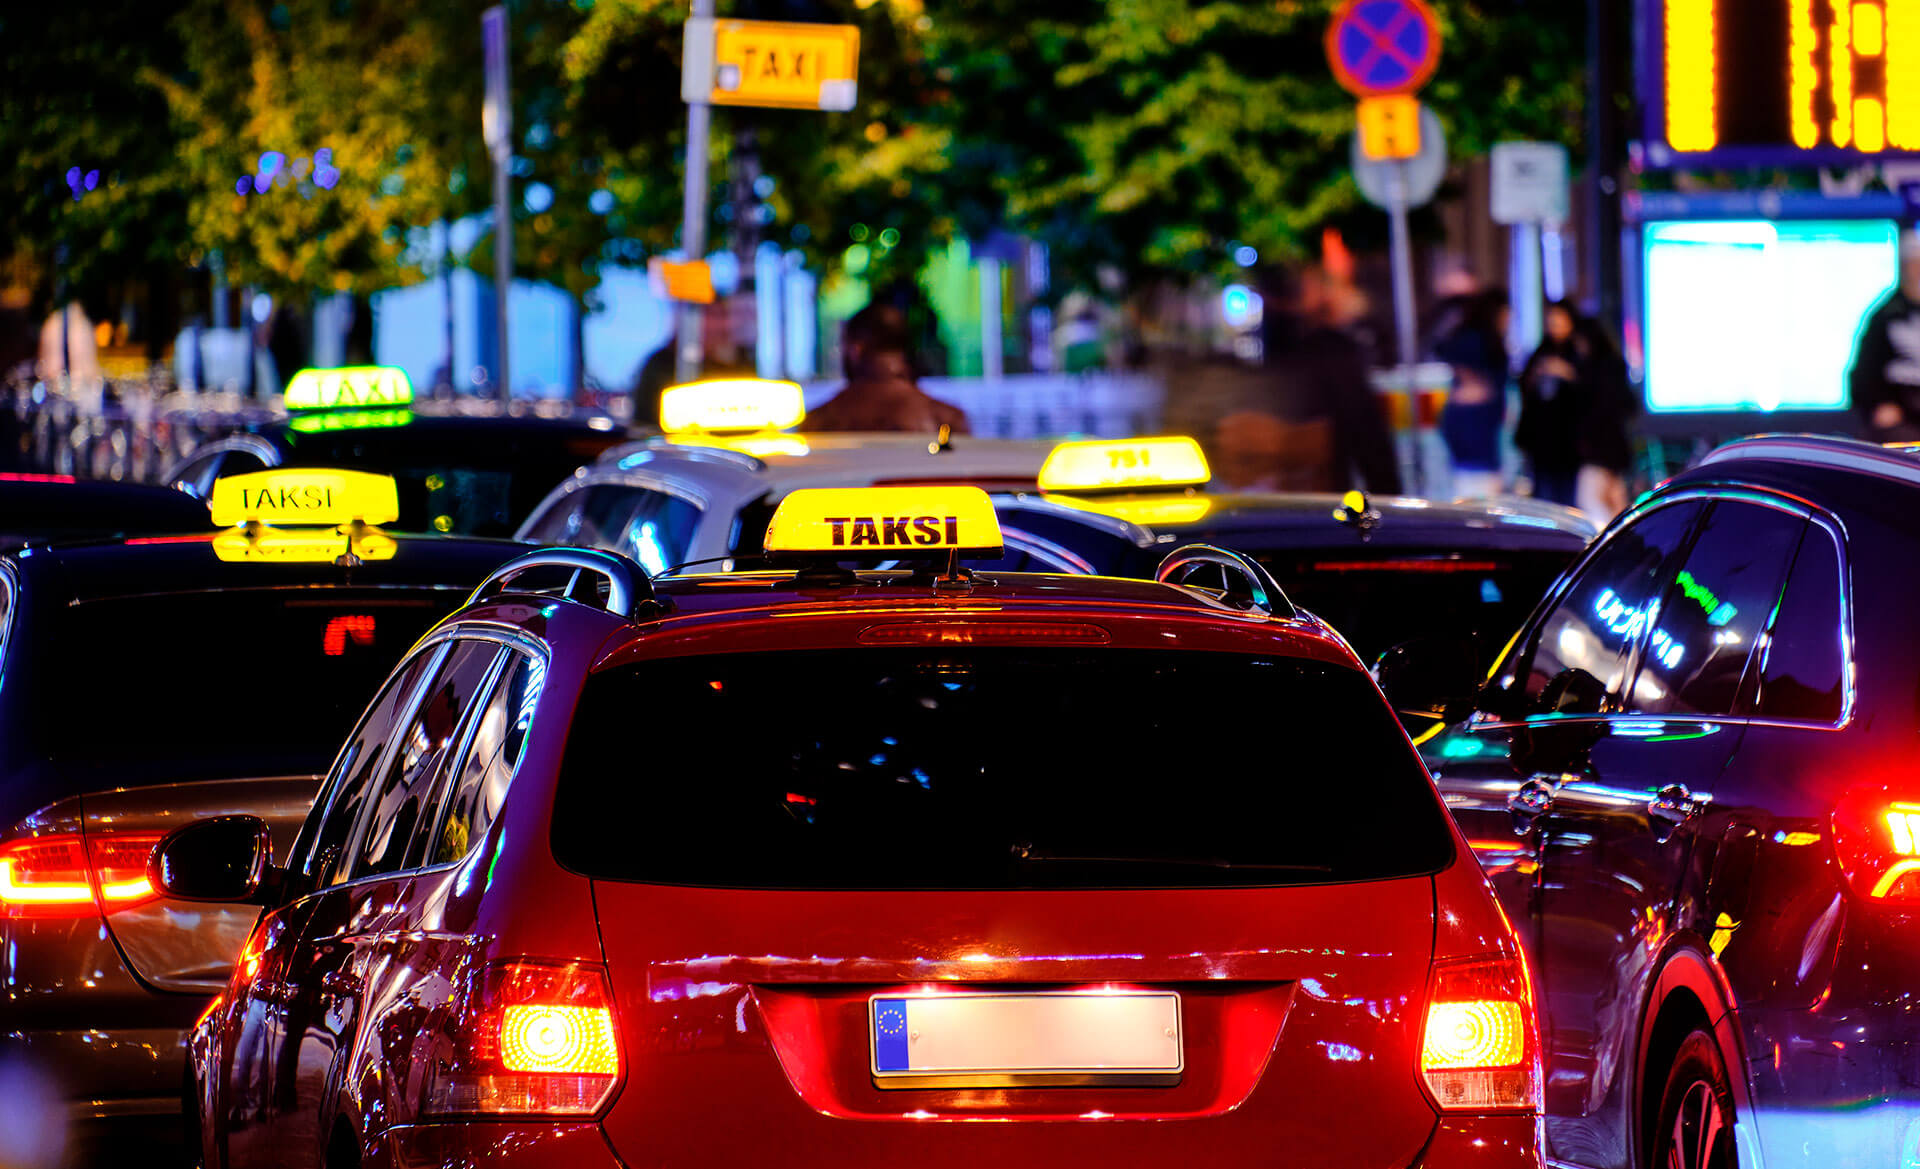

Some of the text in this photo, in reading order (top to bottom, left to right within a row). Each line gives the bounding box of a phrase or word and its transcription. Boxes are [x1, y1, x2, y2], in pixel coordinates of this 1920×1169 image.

[739, 46, 828, 78] TAXI
[309, 374, 398, 405] TAXI
[242, 488, 333, 510] TAKSI
[823, 516, 959, 546] TAKSI
